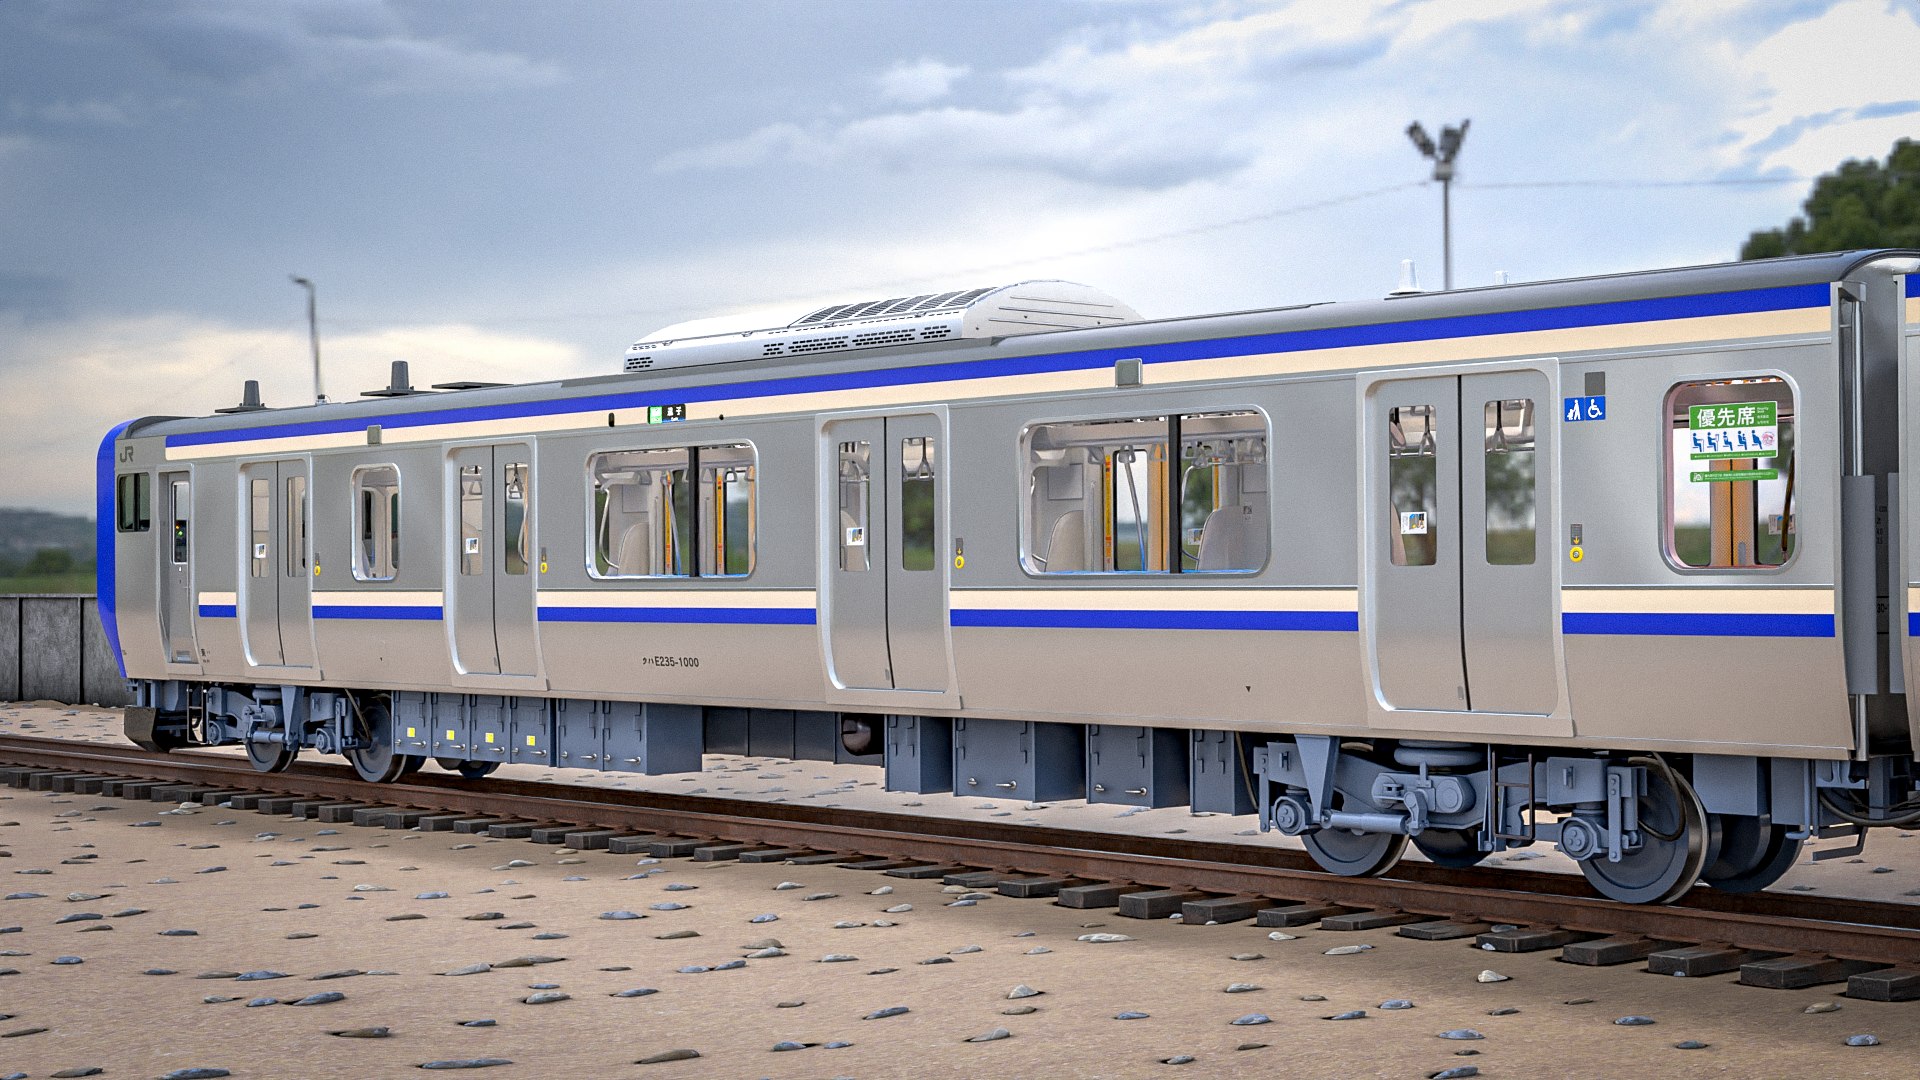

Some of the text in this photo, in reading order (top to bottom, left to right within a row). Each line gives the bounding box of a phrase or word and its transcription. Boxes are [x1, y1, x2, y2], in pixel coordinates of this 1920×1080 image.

[1697, 406, 1755, 428] 優先席
[119, 445, 134, 463] JR
